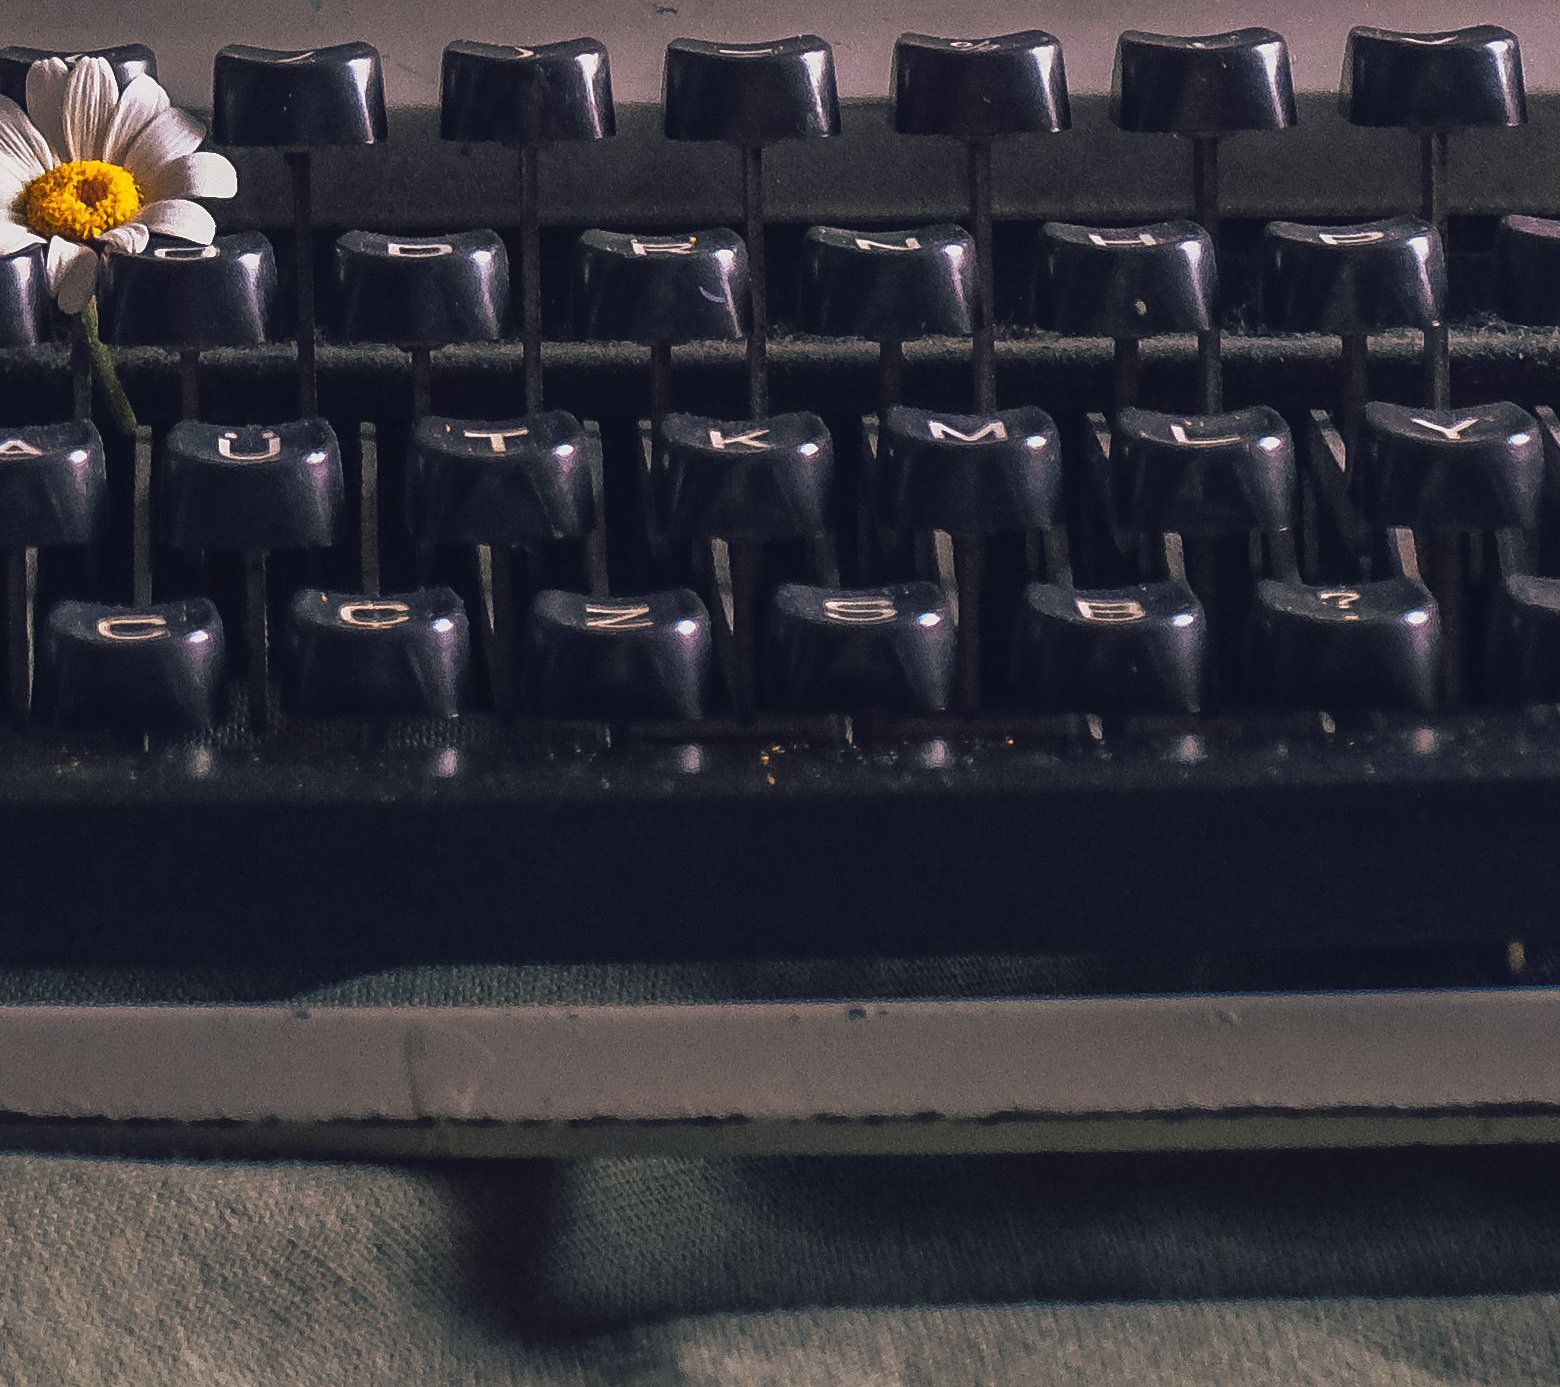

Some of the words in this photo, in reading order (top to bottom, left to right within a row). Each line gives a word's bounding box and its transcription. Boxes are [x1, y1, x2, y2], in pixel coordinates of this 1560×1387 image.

[387, 242, 454, 258] D
[463, 426, 530, 454] T
[709, 428, 773, 449] K
[928, 419, 1008, 442] M
[1169, 424, 1242, 445] L
[1410, 417, 1480, 440] Y
[585, 603, 655, 629] Z
[823, 598, 898, 623] S
[96, 614, 171, 641] C
